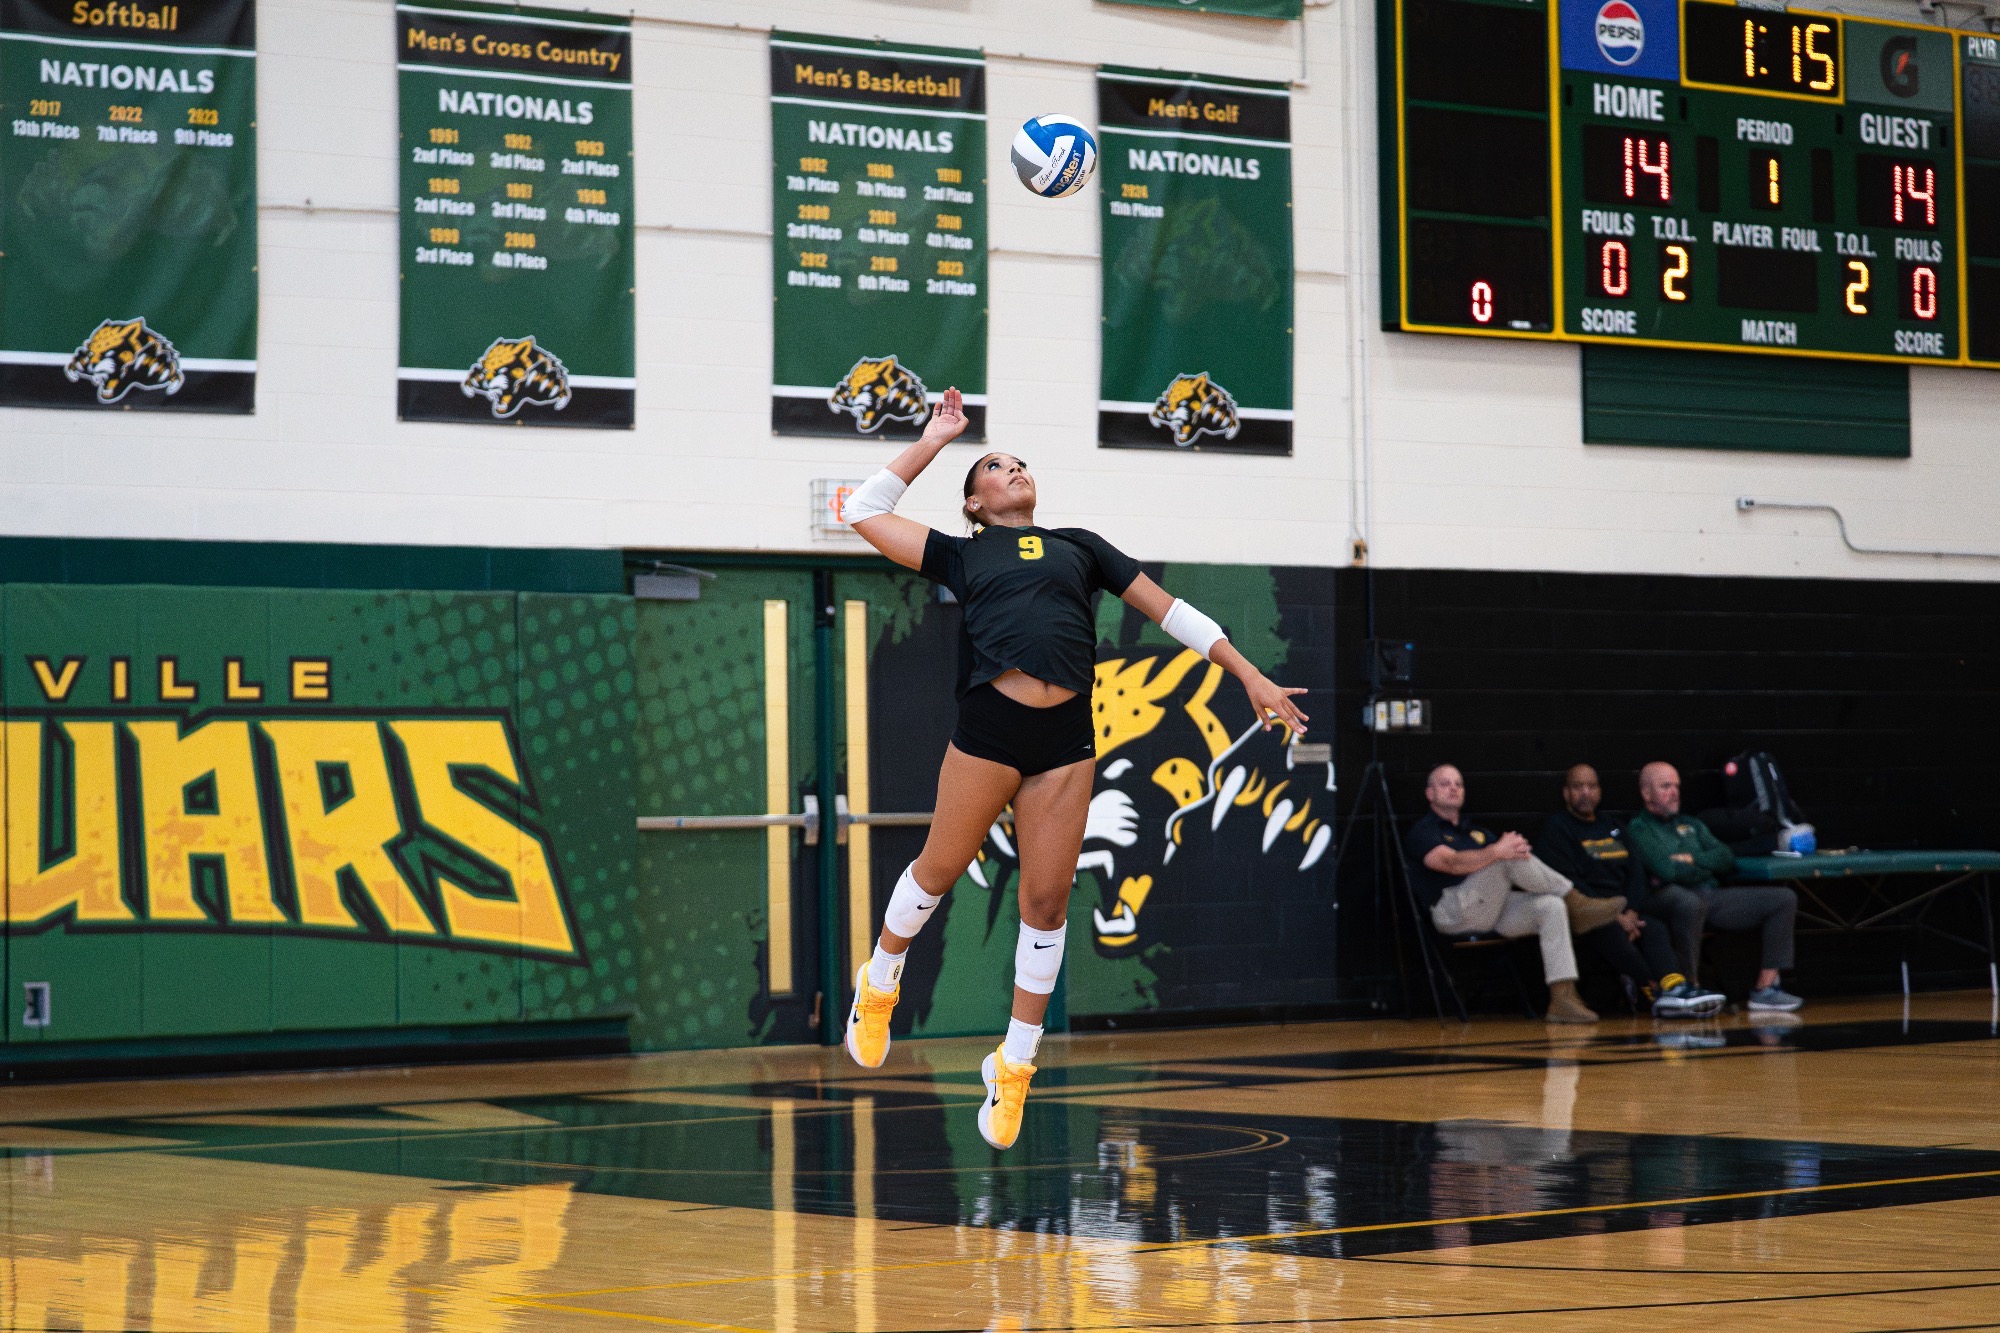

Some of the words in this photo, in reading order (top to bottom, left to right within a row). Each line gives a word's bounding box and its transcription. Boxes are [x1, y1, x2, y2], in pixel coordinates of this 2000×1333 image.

[72, 1, 178, 31] Softball
[1599, 23, 1641, 41] PEPSI
[408, 29, 466, 54] Men's
[472, 35, 532, 59] Cross
[536, 42, 621, 72] Country
[1745, 19, 1834, 91] 1:15
[1968, 36, 1997, 60] PLYR
[41, 60, 214, 94] NATIONALS
[795, 65, 853, 89] Men's
[856, 70, 961, 97] Basketball
[31, 100, 61, 116] 2017
[109, 106, 142, 123] 2022
[439, 89, 594, 125] NATIONALS
[1148, 100, 1199, 120] Men's
[1203, 103, 1239, 123] Golf
[1593, 83, 1665, 121] HOME
[13, 120, 40, 137] 13th
[42, 122, 80, 140] Place
[97, 126, 119, 143] 7th
[118, 127, 158, 145] Place
[198, 130, 234, 147] Place
[808, 120, 954, 154] NATIONALS
[1736, 117, 1794, 146] PERIOD
[1860, 113, 1933, 149] GUEST
[414, 147, 438, 164] 2nd
[439, 149, 475, 167] Place
[490, 152, 513, 170] 3rd
[512, 154, 546, 172] Place
[562, 159, 584, 176] 2nd
[583, 161, 620, 178] Place
[1129, 149, 1260, 180] NATIONALS
[1623, 137, 1670, 200] 14
[1052, 149, 1081, 192] molten
[1769, 159, 1779, 204] 1
[807, 177, 841, 194] Place
[873, 183, 907, 200] Place
[945, 188, 974, 204] Place
[1894, 165, 1936, 225] 14
[415, 197, 439, 214] 2nd
[438, 199, 476, 216] Place
[492, 202, 514, 219] 3rd
[513, 204, 547, 222] Place
[585, 209, 621, 226] Place
[1130, 203, 1164, 218] Place
[807, 225, 843, 241] Place
[1582, 209, 1636, 237] FOULS
[1651, 215, 1698, 243] T.O.L.
[876, 229, 910, 246] Place
[942, 234, 973, 251] Place
[1712, 221, 1774, 249] PLAYER
[1781, 227, 1822, 253] FOUL
[1835, 232, 1878, 258] T.O.L.
[1894, 237, 1943, 263] FOULS
[416, 247, 439, 264] 3rd
[438, 249, 474, 266] Place
[514, 253, 548, 271] Place
[1602, 241, 1628, 296] 0
[806, 272, 842, 289] Place
[877, 276, 910, 293] Place
[1663, 245, 1689, 301] 2
[942, 280, 977, 296] Place
[1846, 261, 1869, 314] 2
[1913, 267, 1936, 319] 0
[1471, 281, 1493, 323] 0
[1581, 307, 1637, 335] SCORE
[1741, 319, 1797, 346] MATCH
[1894, 330, 1944, 356] SCORE
[1018, 536, 1044, 561] 9
[27, 656, 331, 701] VILLE
